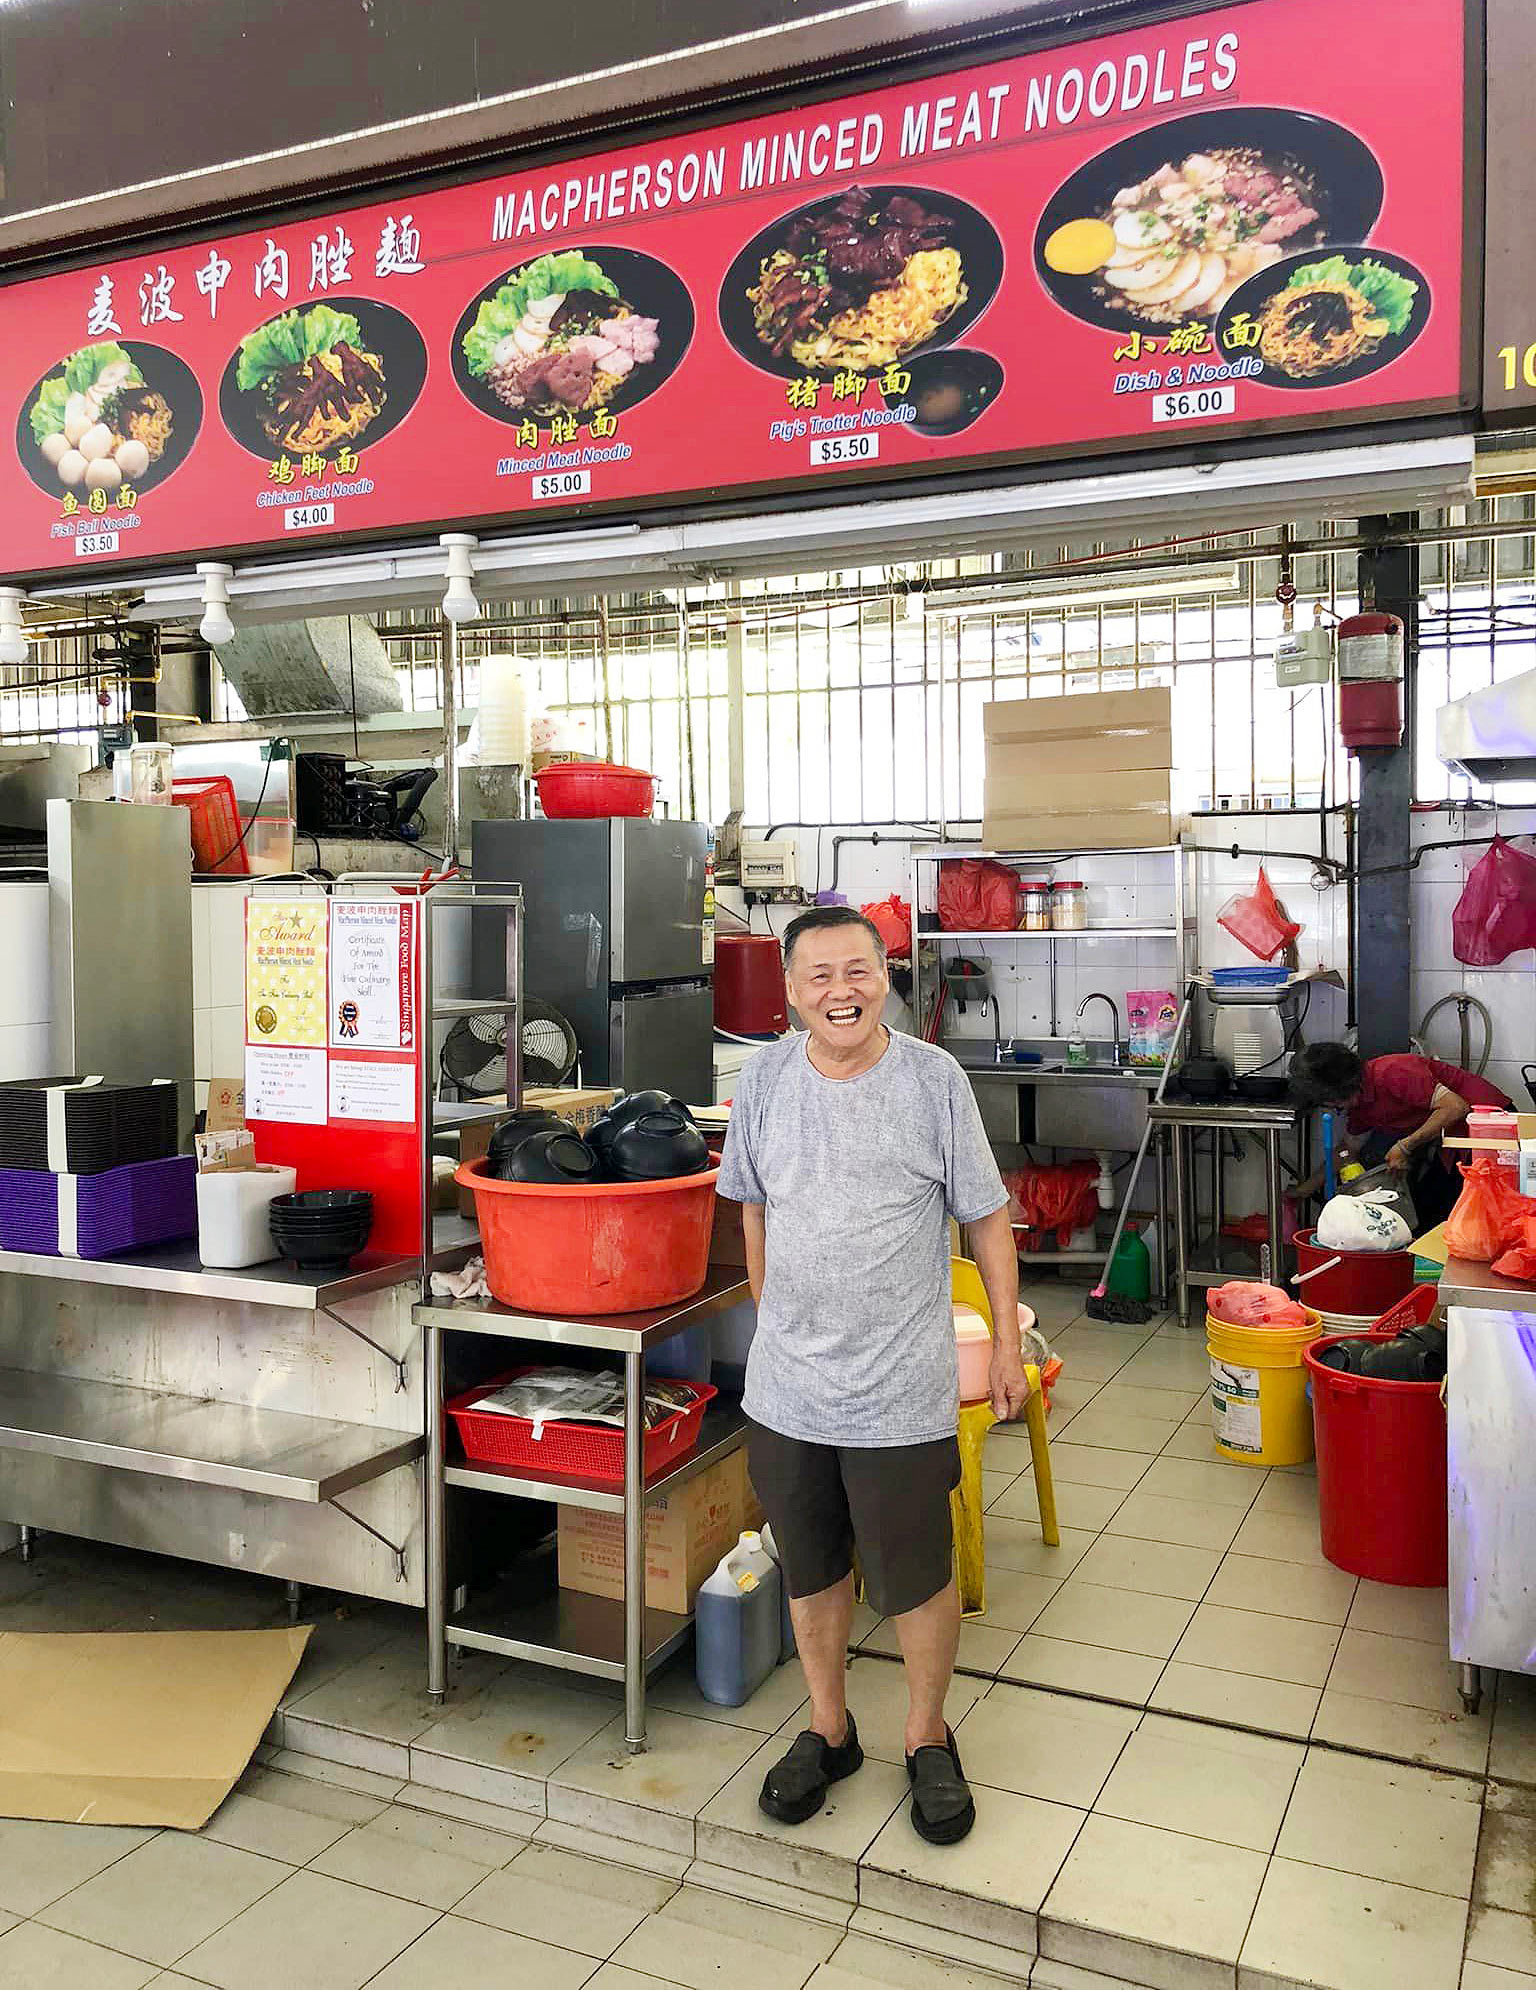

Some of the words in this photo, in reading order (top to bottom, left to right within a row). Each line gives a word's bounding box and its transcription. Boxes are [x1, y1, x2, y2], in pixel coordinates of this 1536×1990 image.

[491, 147, 726, 243] MACPHERSON
[738, 112, 884, 192] MINCED
[900, 84, 1011, 158] MEAT
[1023, 32, 1239, 132] NOODLES
[1113, 312, 1263, 361] 小碗面
[786, 362, 912, 410] 猪脚面
[1113, 368, 1162, 394] Dish
[1165, 365, 1183, 386] &
[1186, 356, 1264, 384] Noodle
[1164, 390, 1223, 418] $6.00
[769, 420, 807, 442] Pig's
[809, 414, 860, 434] Trotter
[861, 403, 917, 428] Noodle
[496, 452, 545, 476] Minced
[546, 450, 581, 469] Meat
[581, 442, 632, 464] Noodle
[821, 437, 869, 462] $5.50
[268, 446, 359, 485] 鸡脚面
[256, 489, 303, 508] Chicken
[303, 485, 330, 502] Feet
[331, 477, 375, 498] Noodle
[541, 474, 582, 496] $5.00
[50, 522, 76, 539] Fish
[76, 518, 100, 535] Ball
[101, 513, 142, 531] Noodle
[293, 506, 328, 527] $4.00
[82, 535, 113, 553] $3.50
[259, 925, 316, 941] Award
[400, 909, 412, 938] Map
[400, 941, 409, 968] Food
[400, 971, 412, 1030] Singapore
